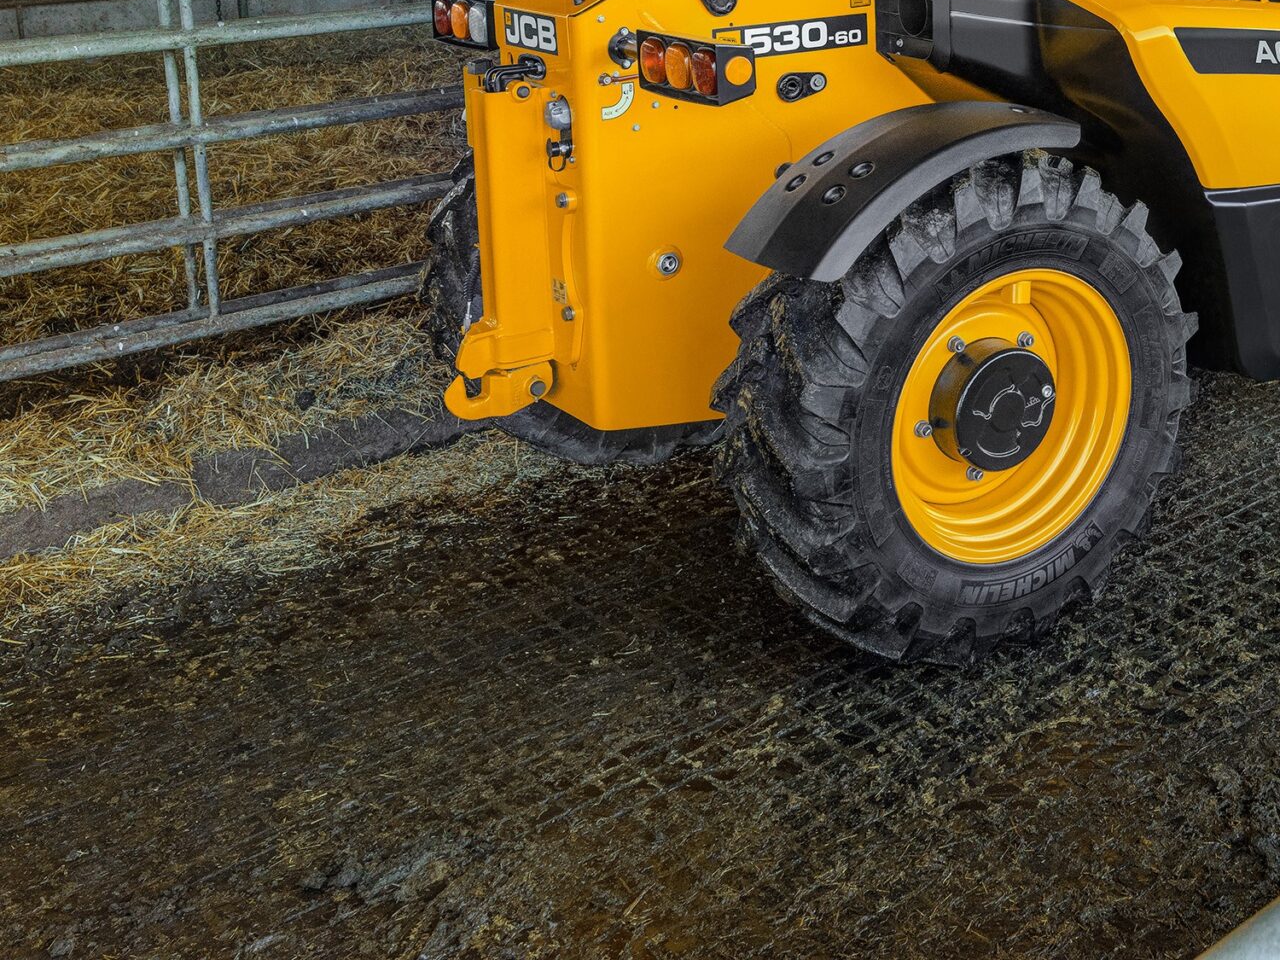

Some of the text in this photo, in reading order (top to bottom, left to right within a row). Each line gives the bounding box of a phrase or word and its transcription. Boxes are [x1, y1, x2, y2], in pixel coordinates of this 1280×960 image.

[506, 13, 557, 52] JCB
[744, 21, 862, 55] 530-60
[967, 231, 1088, 273] MICHELIN
[960, 547, 1076, 606] MICHELIN
